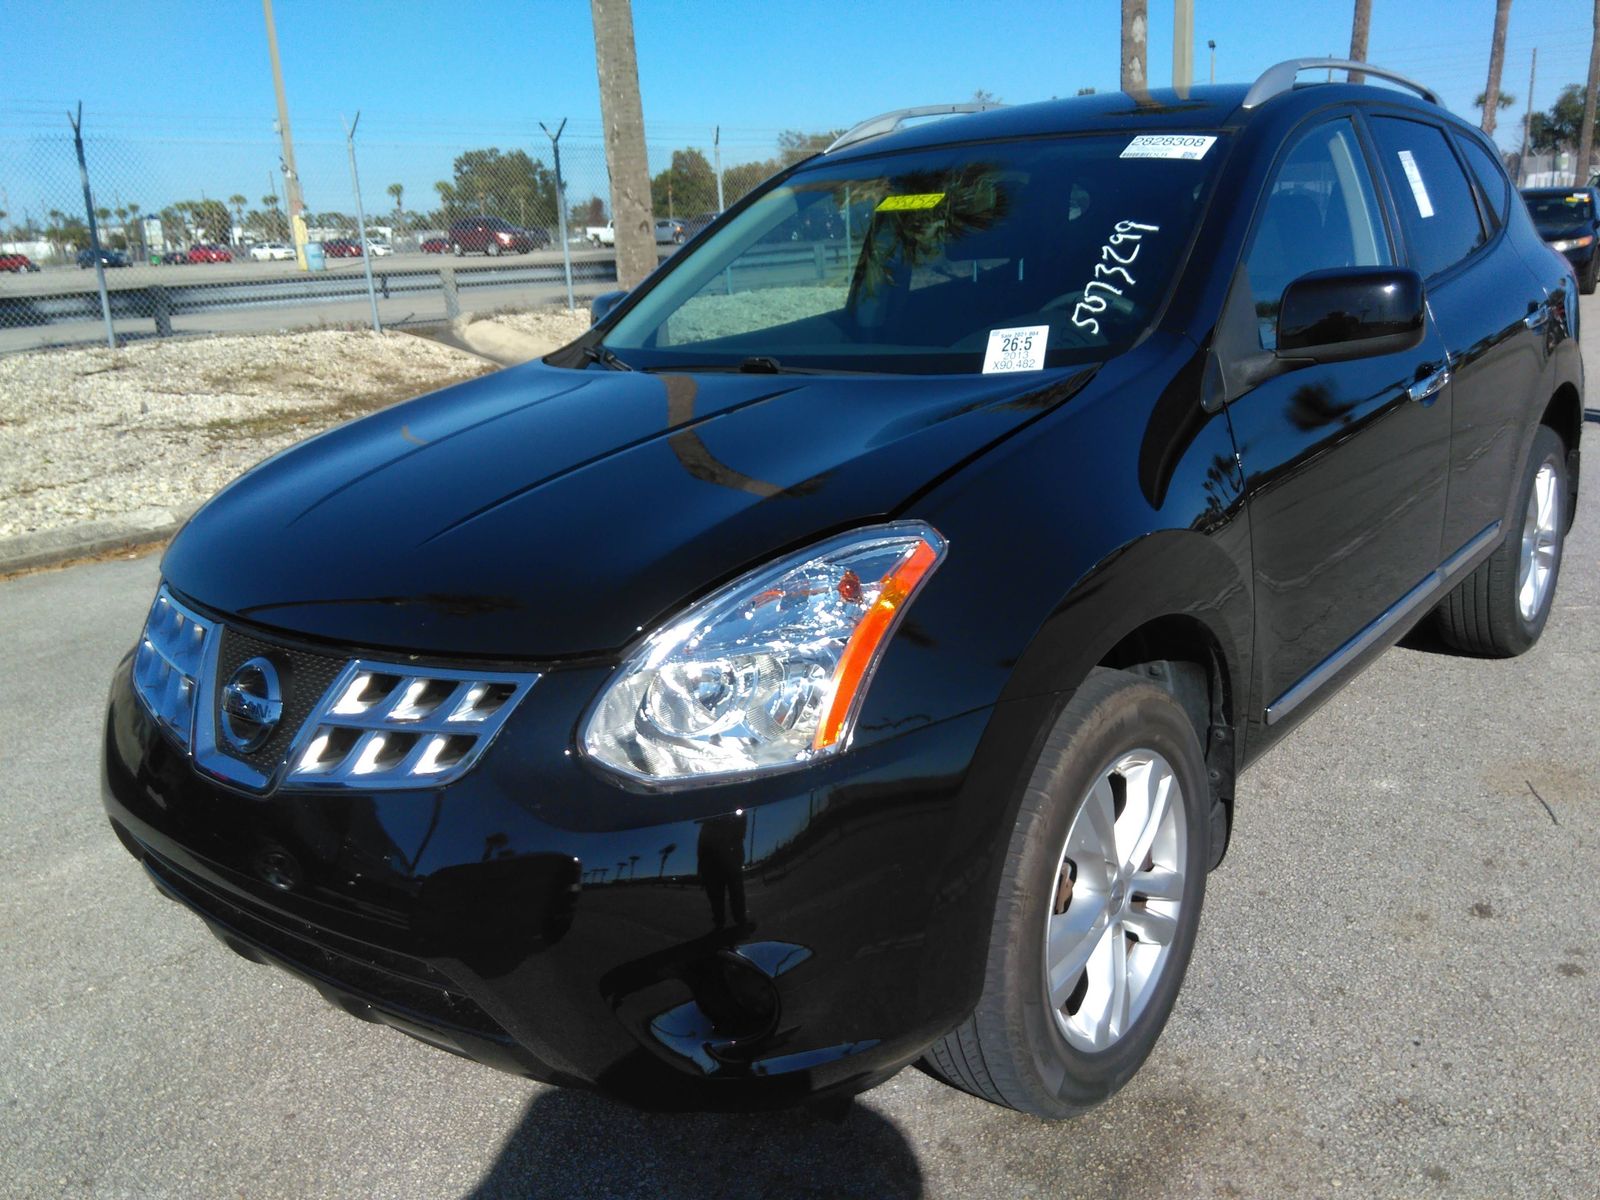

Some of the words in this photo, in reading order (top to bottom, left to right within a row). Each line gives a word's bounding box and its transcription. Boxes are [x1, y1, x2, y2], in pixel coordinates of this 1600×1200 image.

[1131, 137, 1206, 147] 2828308
[1071, 220, 1160, 335] 5073299
[1002, 336, 1032, 352] 26:5
[1003, 351, 1029, 360] 2013
